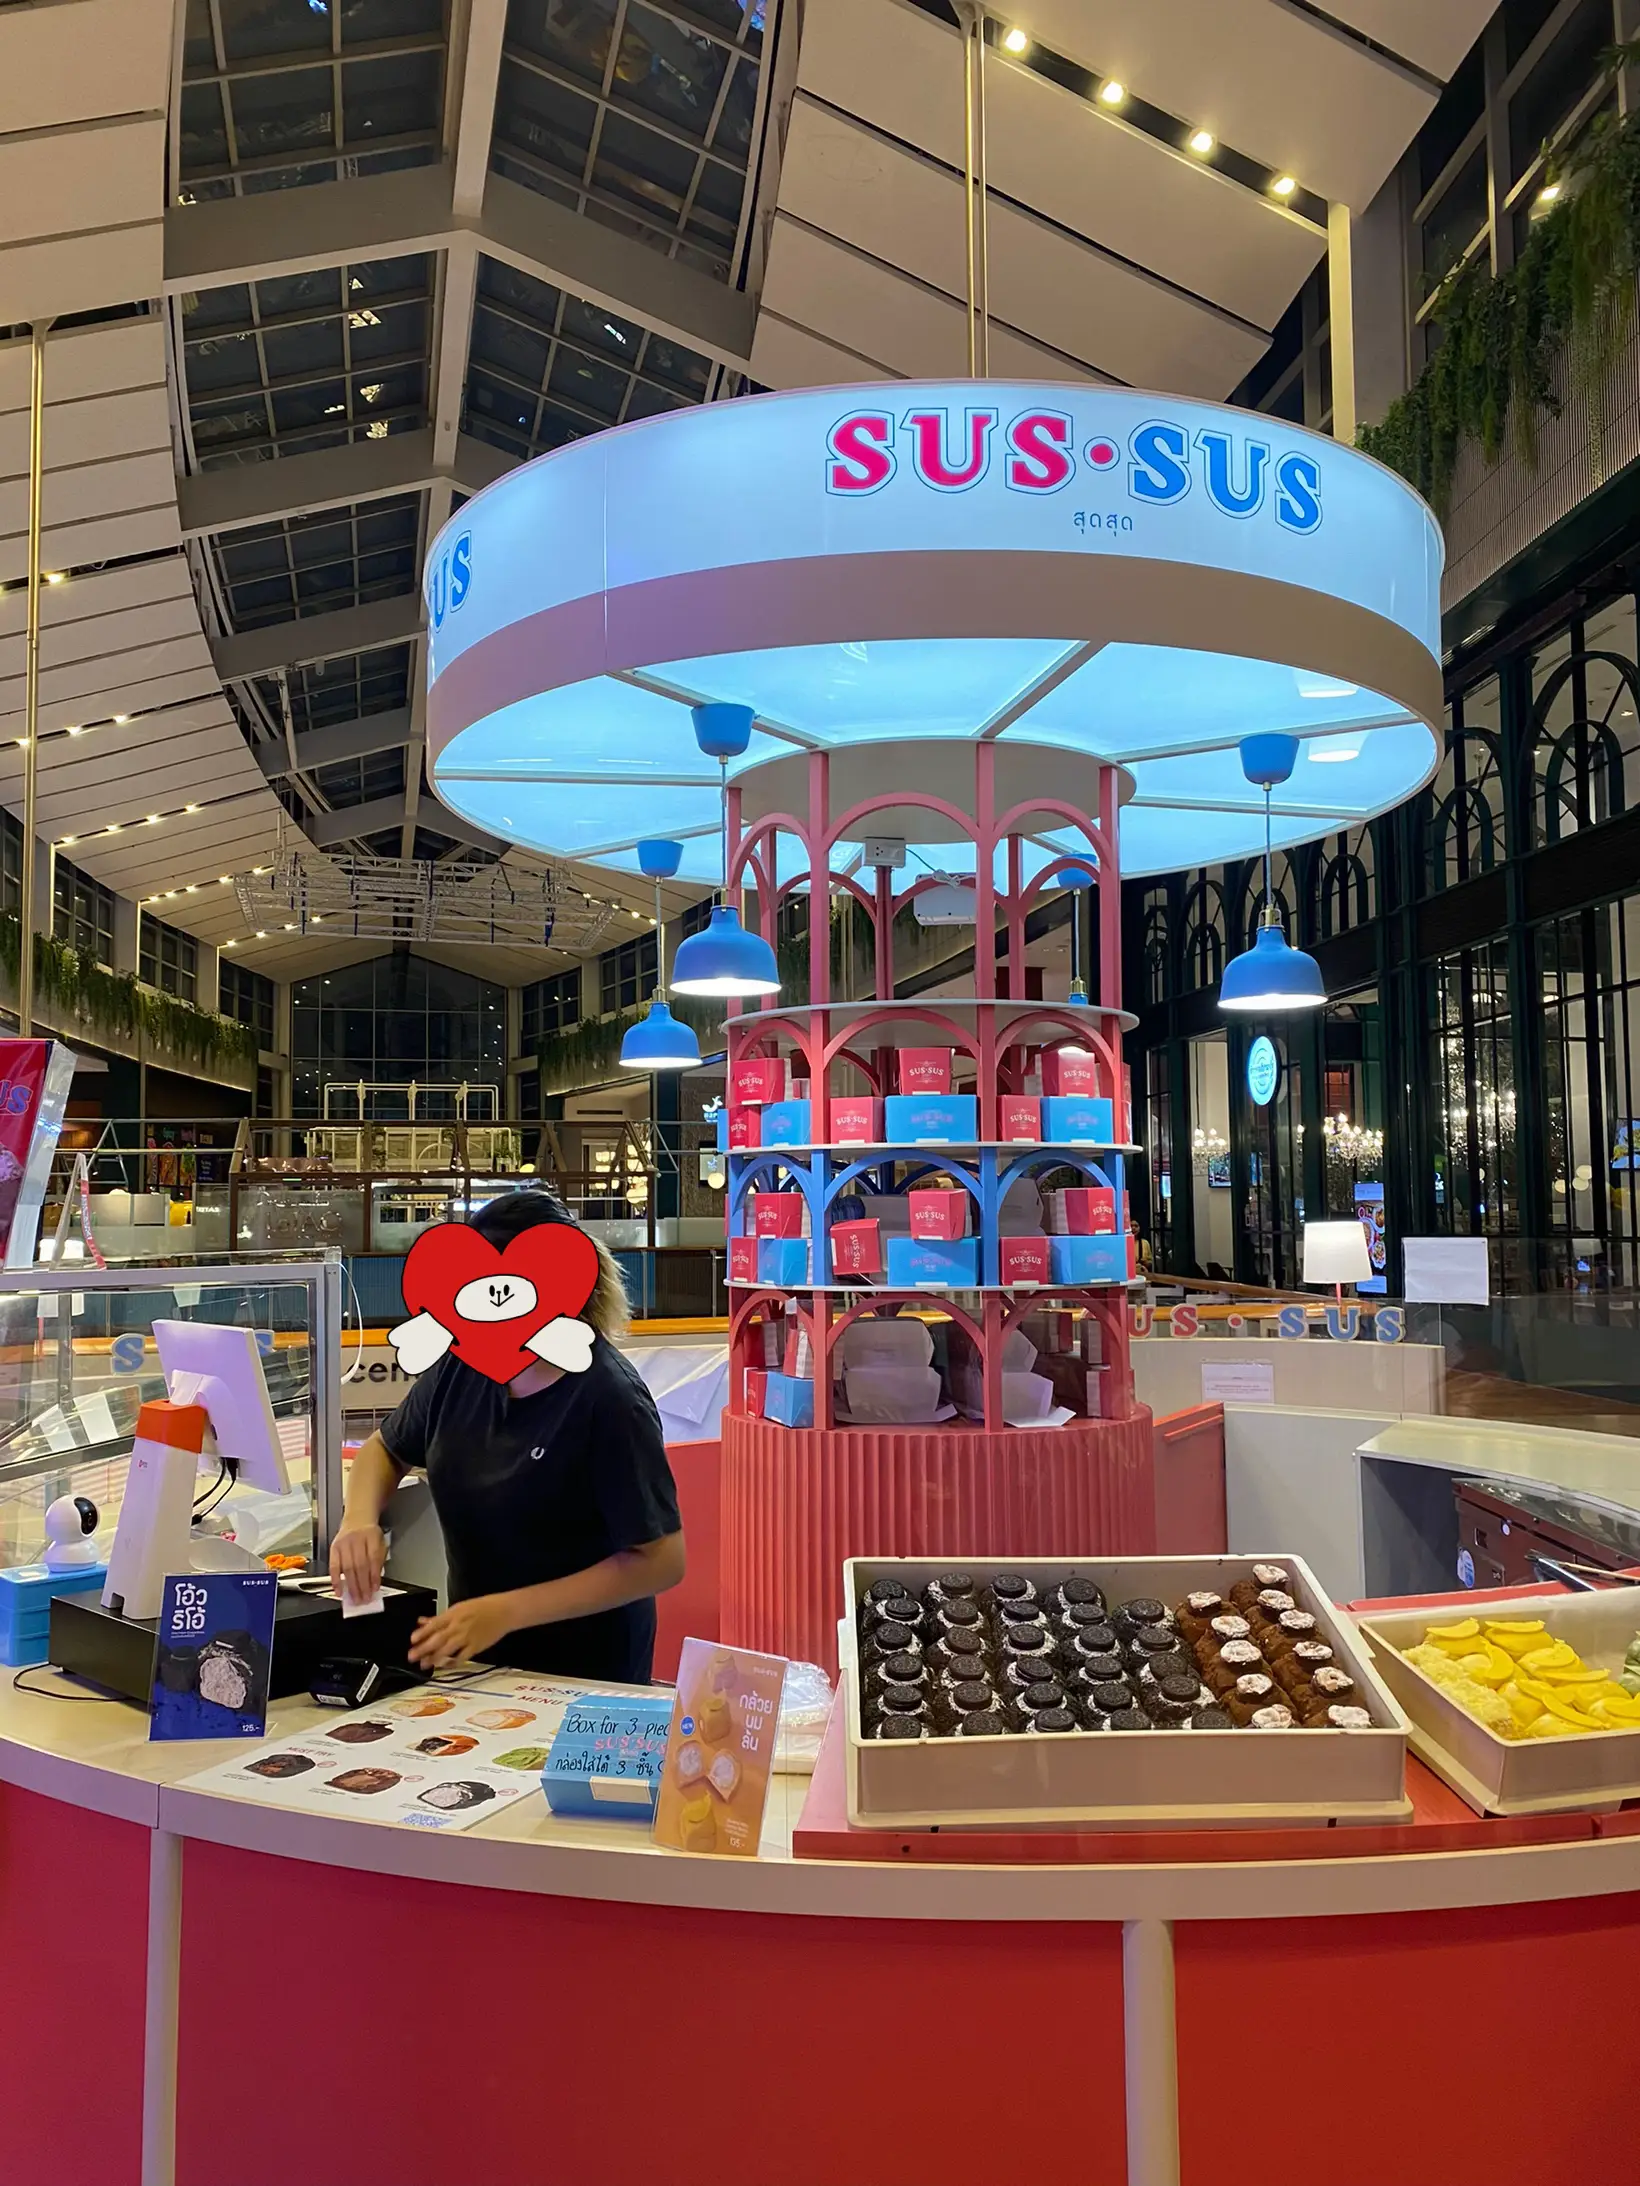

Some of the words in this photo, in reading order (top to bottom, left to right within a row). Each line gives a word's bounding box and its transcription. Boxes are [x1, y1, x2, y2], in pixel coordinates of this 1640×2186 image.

[1073, 511, 1133, 537] สุดสุด
[346, 1362, 418, 1383] cen
[518, 1695, 563, 1706] MENU
[566, 1713, 597, 1733] Box
[599, 1715, 620, 1734] for
[625, 1717, 638, 1736] 3
[615, 1760, 627, 1775] 3
